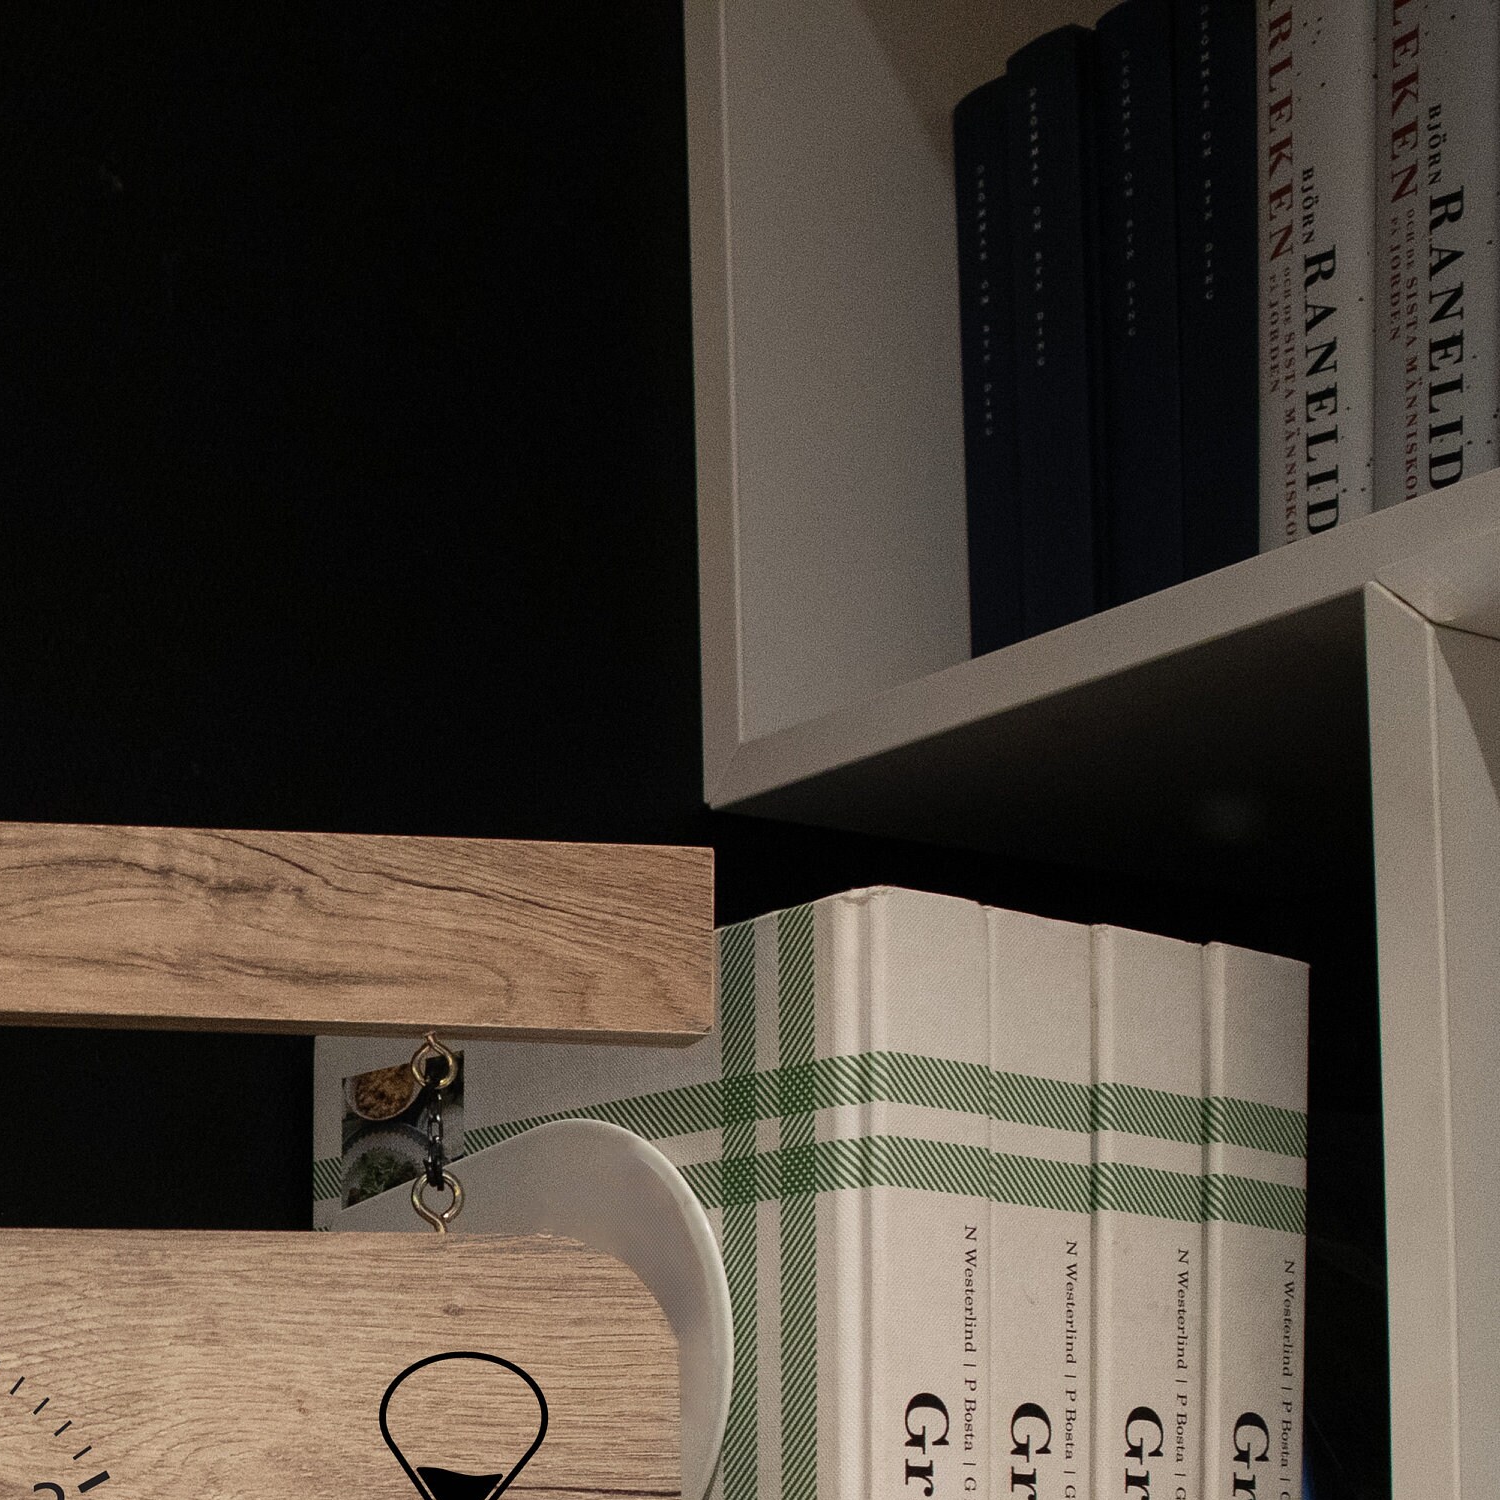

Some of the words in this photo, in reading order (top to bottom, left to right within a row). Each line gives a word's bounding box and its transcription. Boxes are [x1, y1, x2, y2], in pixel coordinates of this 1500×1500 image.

[1268, 0, 1294, 261] RLEKEN
[1426, 104, 1448, 186] BJÖRN
[1301, 166, 1319, 246] BJÖRN
[1389, 244, 1402, 341] JORDEN
[1406, 276, 1418, 347] SISTA
[1269, 300, 1281, 393] JORDEN
[1284, 331, 1296, 399] SISTA
[1429, 185, 1463, 491] RANELID
[1304, 244, 1339, 535] RANELID
[1284, 408, 1301, 544] MÄNNISKO
[964, 1224, 978, 1241] N
[1066, 1240, 1078, 1257] N
[1177, 1248, 1190, 1265] N
[1284, 1259, 1295, 1275] N
[964, 1244, 978, 1353] Westerlind
[1065, 1260, 1078, 1364] Westerlind
[1176, 1269, 1190, 1370] Westerlind
[1282, 1279, 1295, 1378] Westerlind
[964, 1377, 977, 1392] P
[1065, 1388, 1077, 1402] P
[1176, 1393, 1188, 1407] P
[1281, 1400, 1293, 1414] P
[963, 1398, 977, 1452] Bosta
[1065, 1407, 1077, 1460] Bosta
[1175, 1412, 1188, 1463] Bosta
[1280, 1419, 1293, 1468] Bosta
[964, 1476, 977, 1492] G
[1064, 1484, 1077, 1499] G
